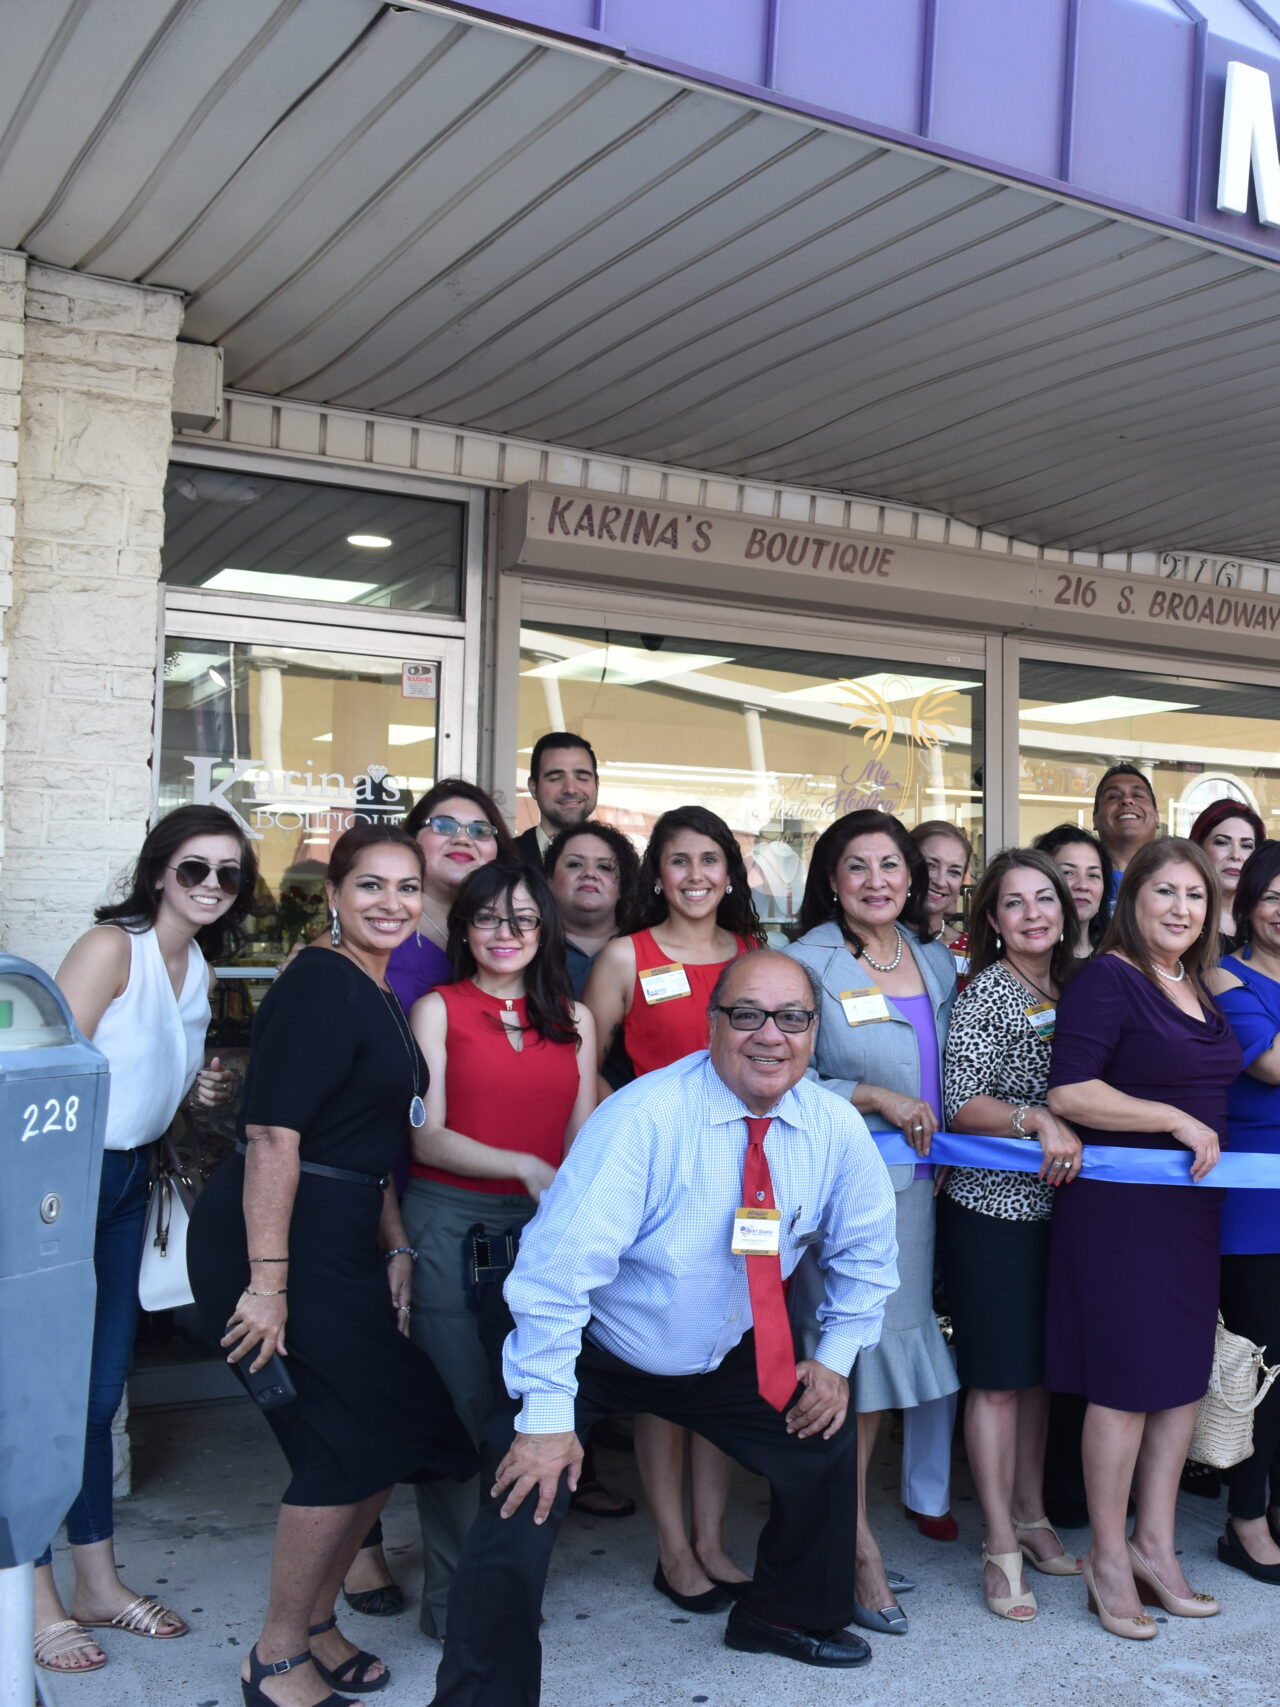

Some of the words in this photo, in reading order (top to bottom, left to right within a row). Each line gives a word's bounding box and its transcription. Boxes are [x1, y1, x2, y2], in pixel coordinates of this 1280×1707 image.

[547, 496, 713, 552] KARINA'S
[744, 527, 895, 577] BOUTIQUE
[1054, 574, 1097, 608] 216
[1117, 585, 1136, 616] S.
[21, 1095, 80, 1142] 228
